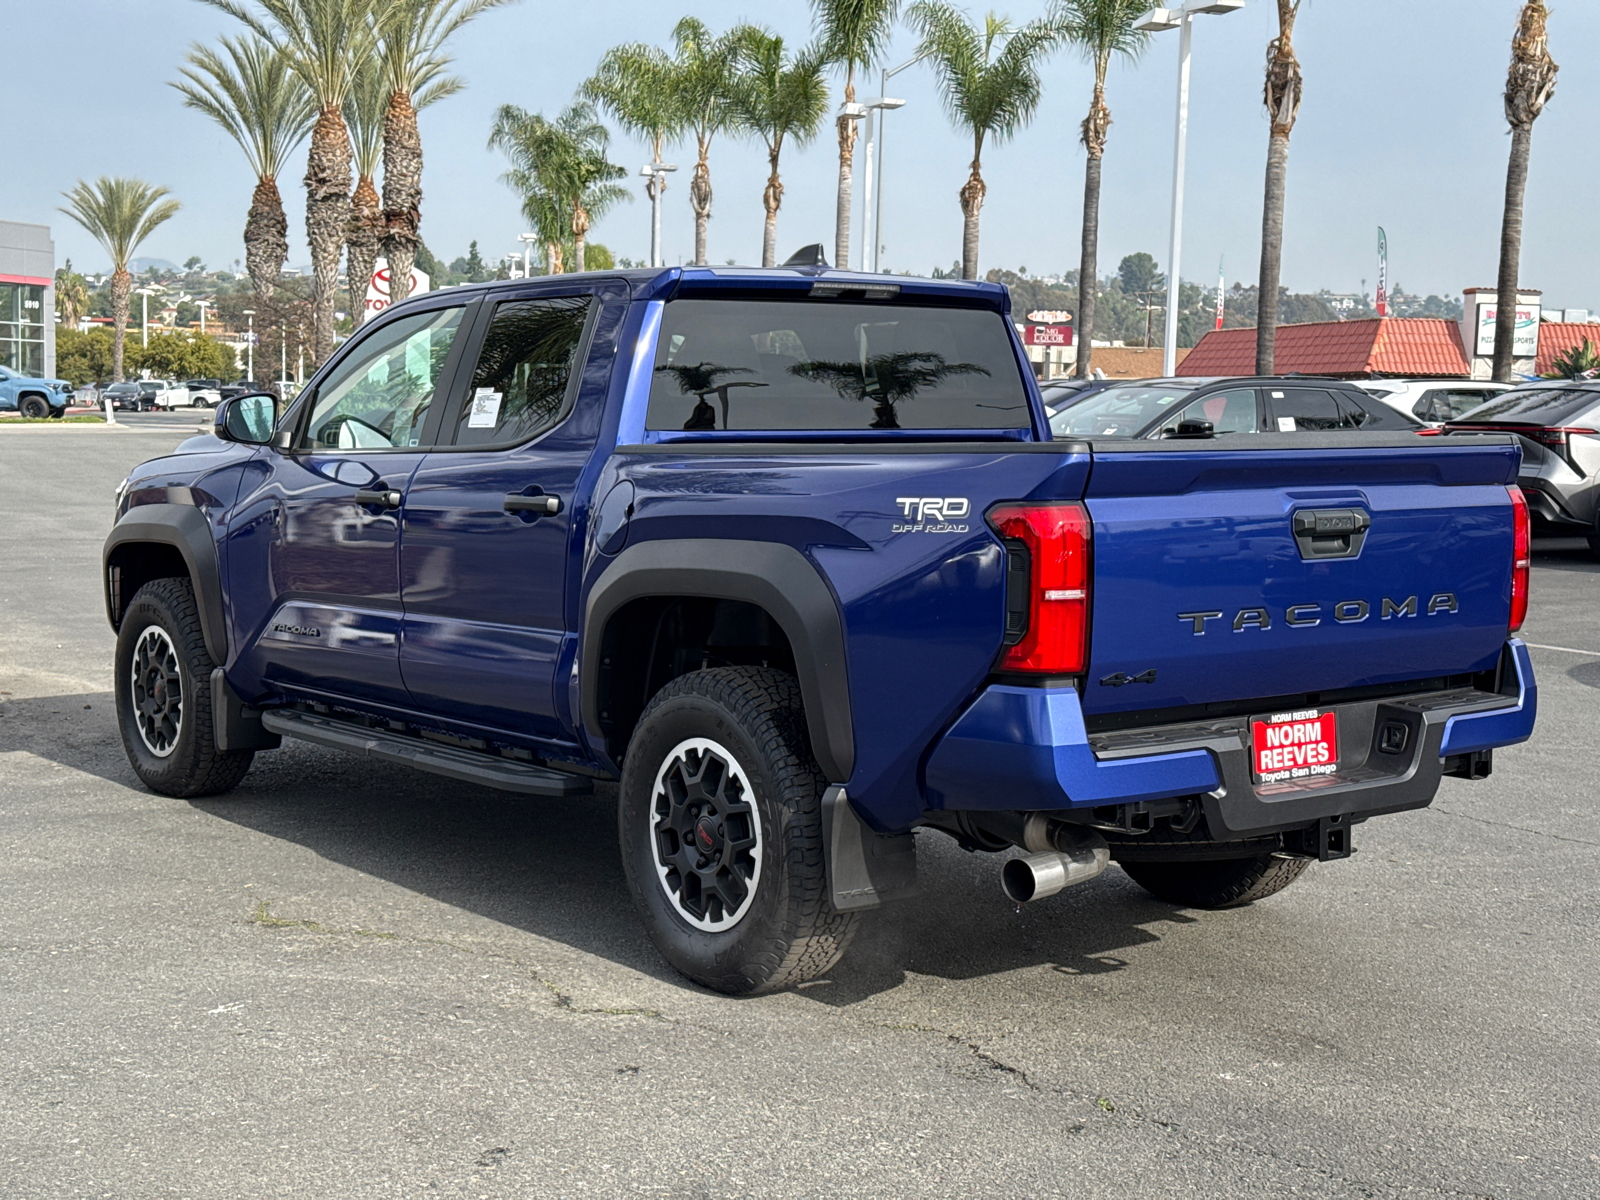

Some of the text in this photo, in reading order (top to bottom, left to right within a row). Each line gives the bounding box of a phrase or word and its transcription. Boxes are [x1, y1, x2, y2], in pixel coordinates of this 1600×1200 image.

[896, 497, 970, 523] TRD
[891, 523, 969, 533] OFF ROAD
[1317, 517, 1353, 529] TOYOTA
[1177, 592, 1459, 636] TACOMA
[271, 623, 320, 638] TACOMA
[1271, 710, 1318, 724] NORM REEVES
[1266, 722, 1321, 748] NORM
[1260, 742, 1329, 770] REEVES
[1260, 764, 1337, 783] Toyota San Diego
